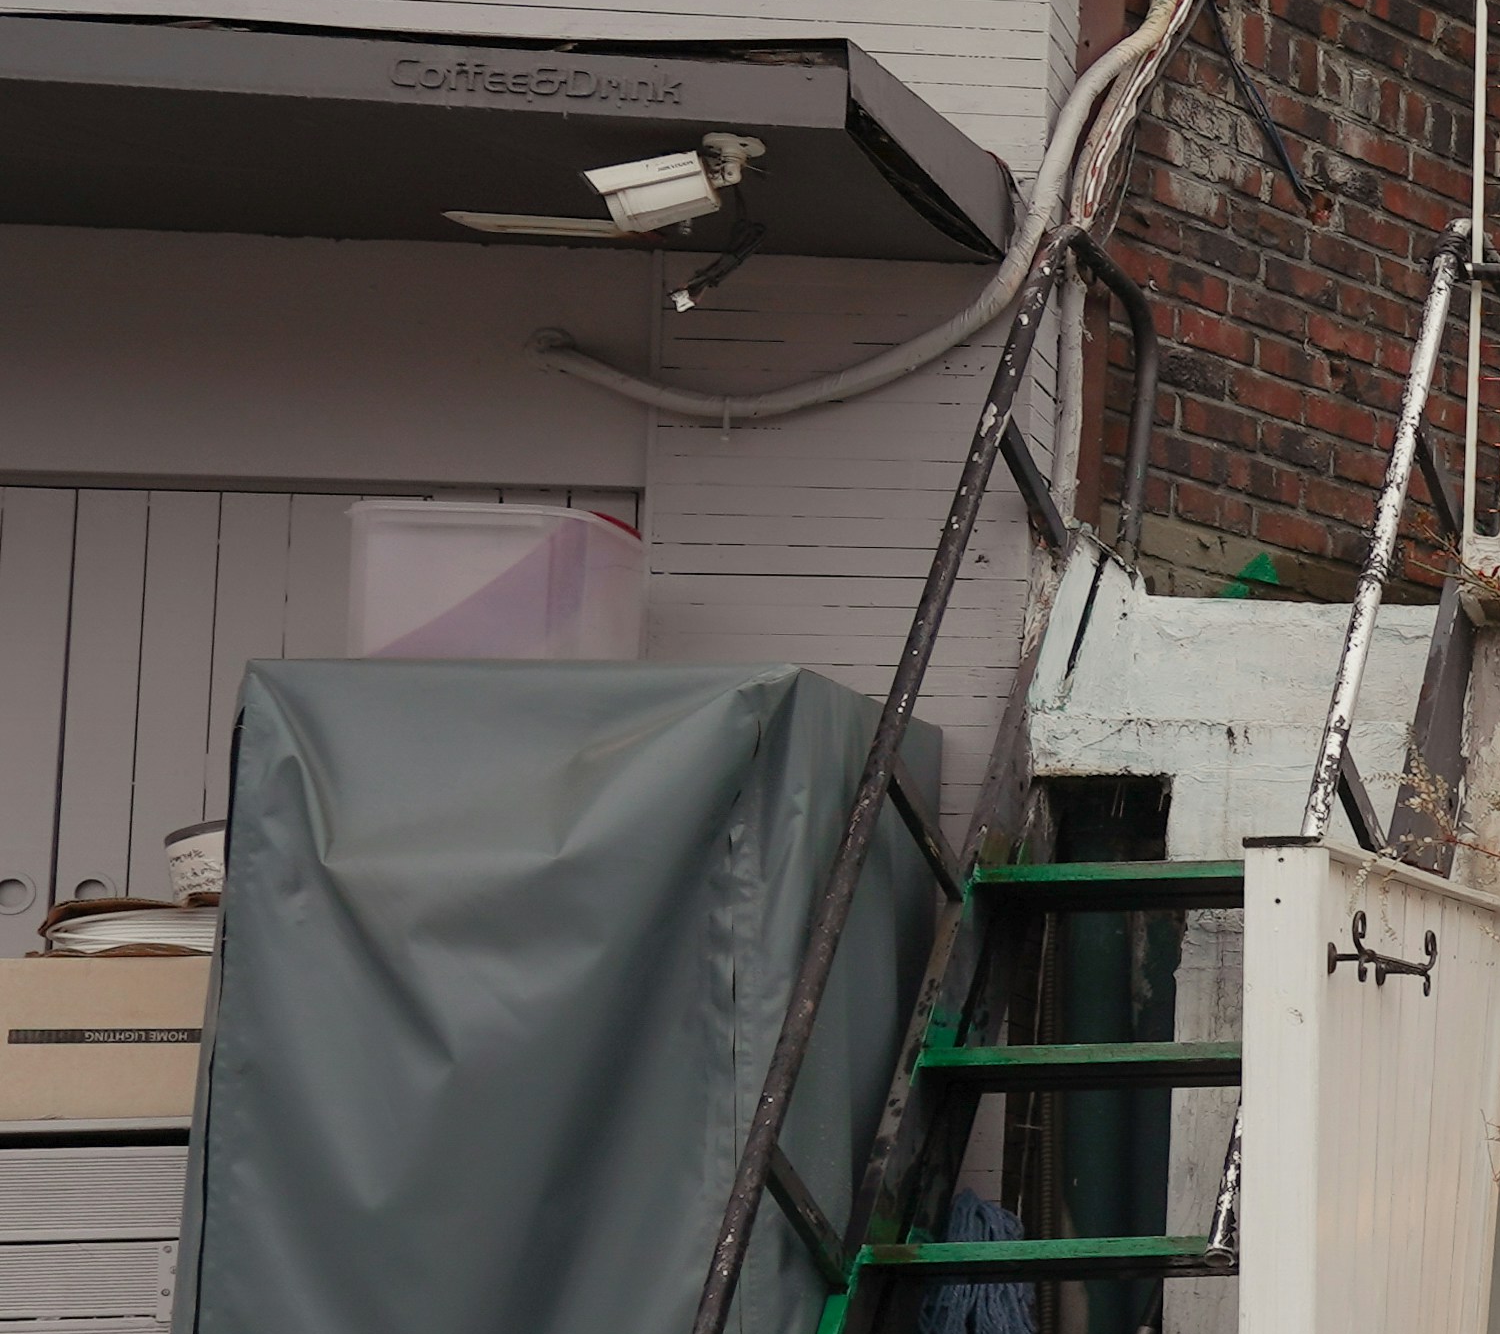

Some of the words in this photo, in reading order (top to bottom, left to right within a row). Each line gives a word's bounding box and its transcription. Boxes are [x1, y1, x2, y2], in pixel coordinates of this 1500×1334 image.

[390, 58, 683, 105] Coffee&Drink
[84, 1031, 146, 1042] LIGHTING
[149, 1031, 188, 1041] HOME
